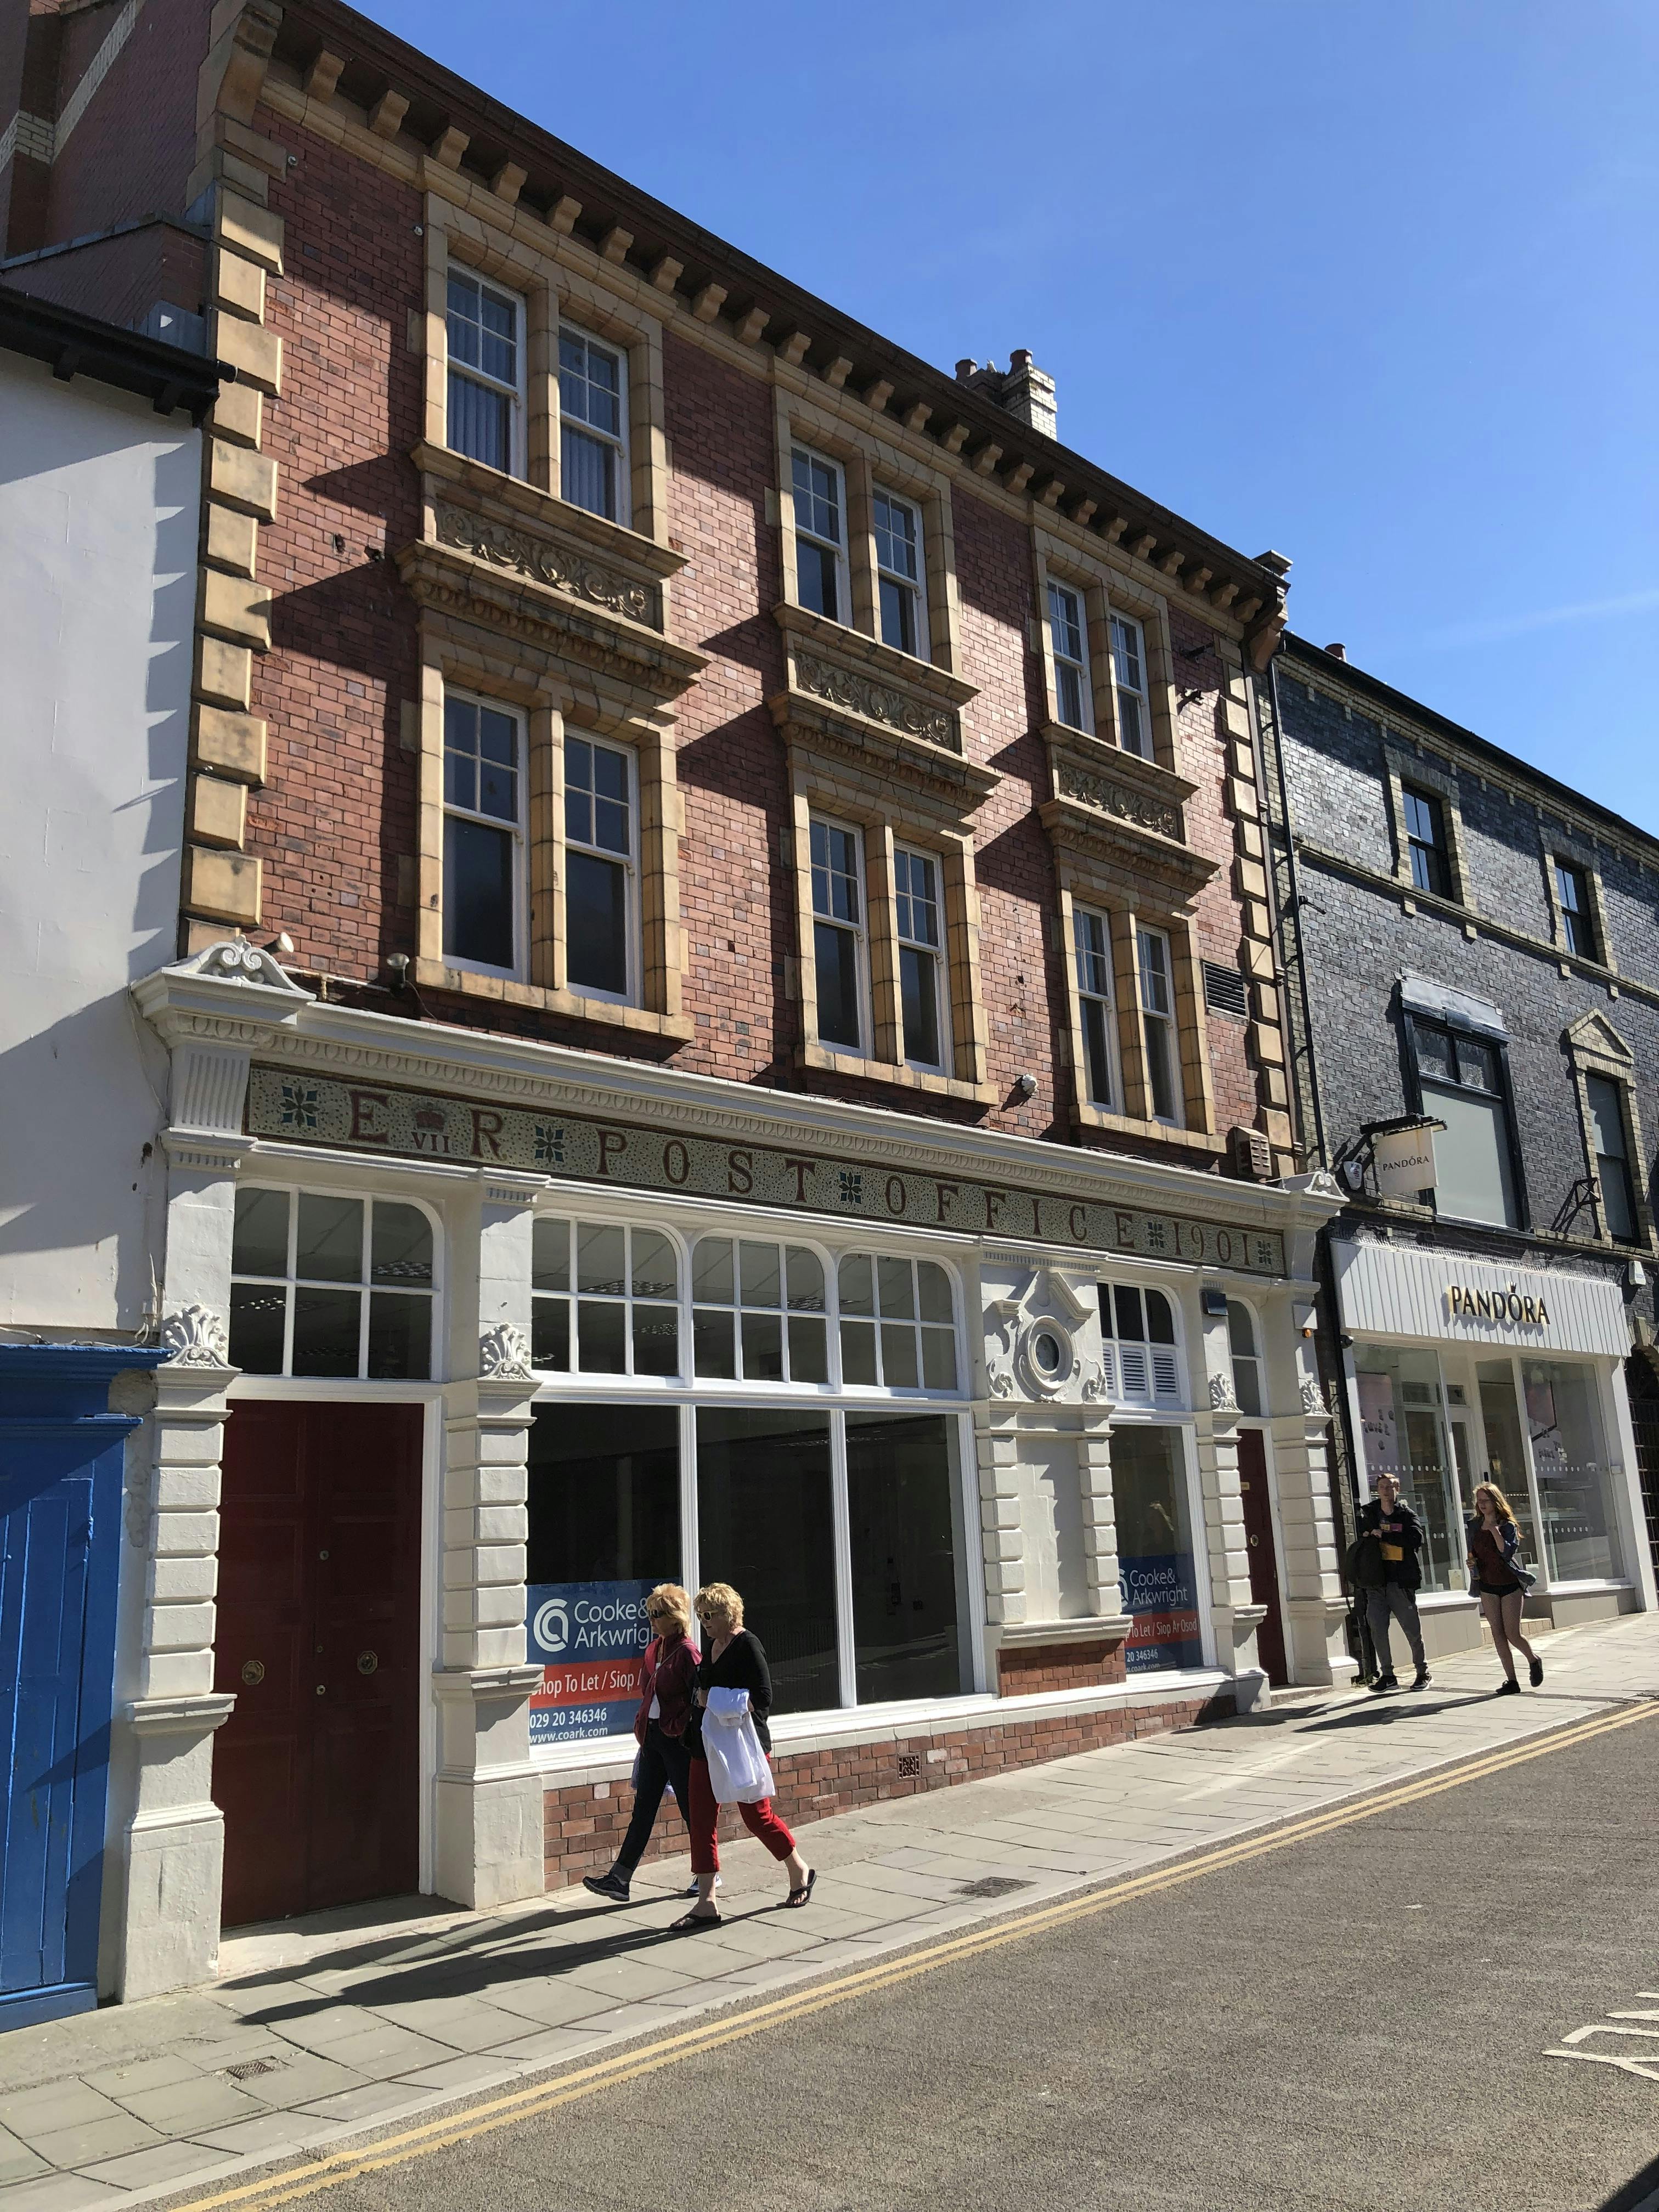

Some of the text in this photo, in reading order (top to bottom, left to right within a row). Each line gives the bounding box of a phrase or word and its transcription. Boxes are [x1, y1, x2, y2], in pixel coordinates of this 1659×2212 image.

[1383, 1155, 1430, 1171] PANDORA
[348, 1088, 1250, 1266] E VII R POST OFFICE 1901
[1451, 1283, 1550, 1325] PANDORA
[1130, 1568, 1176, 1587] Cooke&
[1132, 1587, 1188, 1606] Arkwright
[574, 1598, 648, 1623] Cooke&
[574, 1623, 653, 1649] Arkwrig
[1140, 1623, 1151, 1637] Let
[1156, 1621, 1171, 1638] Siop
[1136, 1648, 1158, 1661] 346346
[565, 1674, 578, 1693] To
[581, 1673, 600, 1691] Let
[610, 1670, 635, 1691] Siop
[529, 1707, 607, 1729] 029 20 346346
[529, 1727, 608, 1743] www.coark.com
